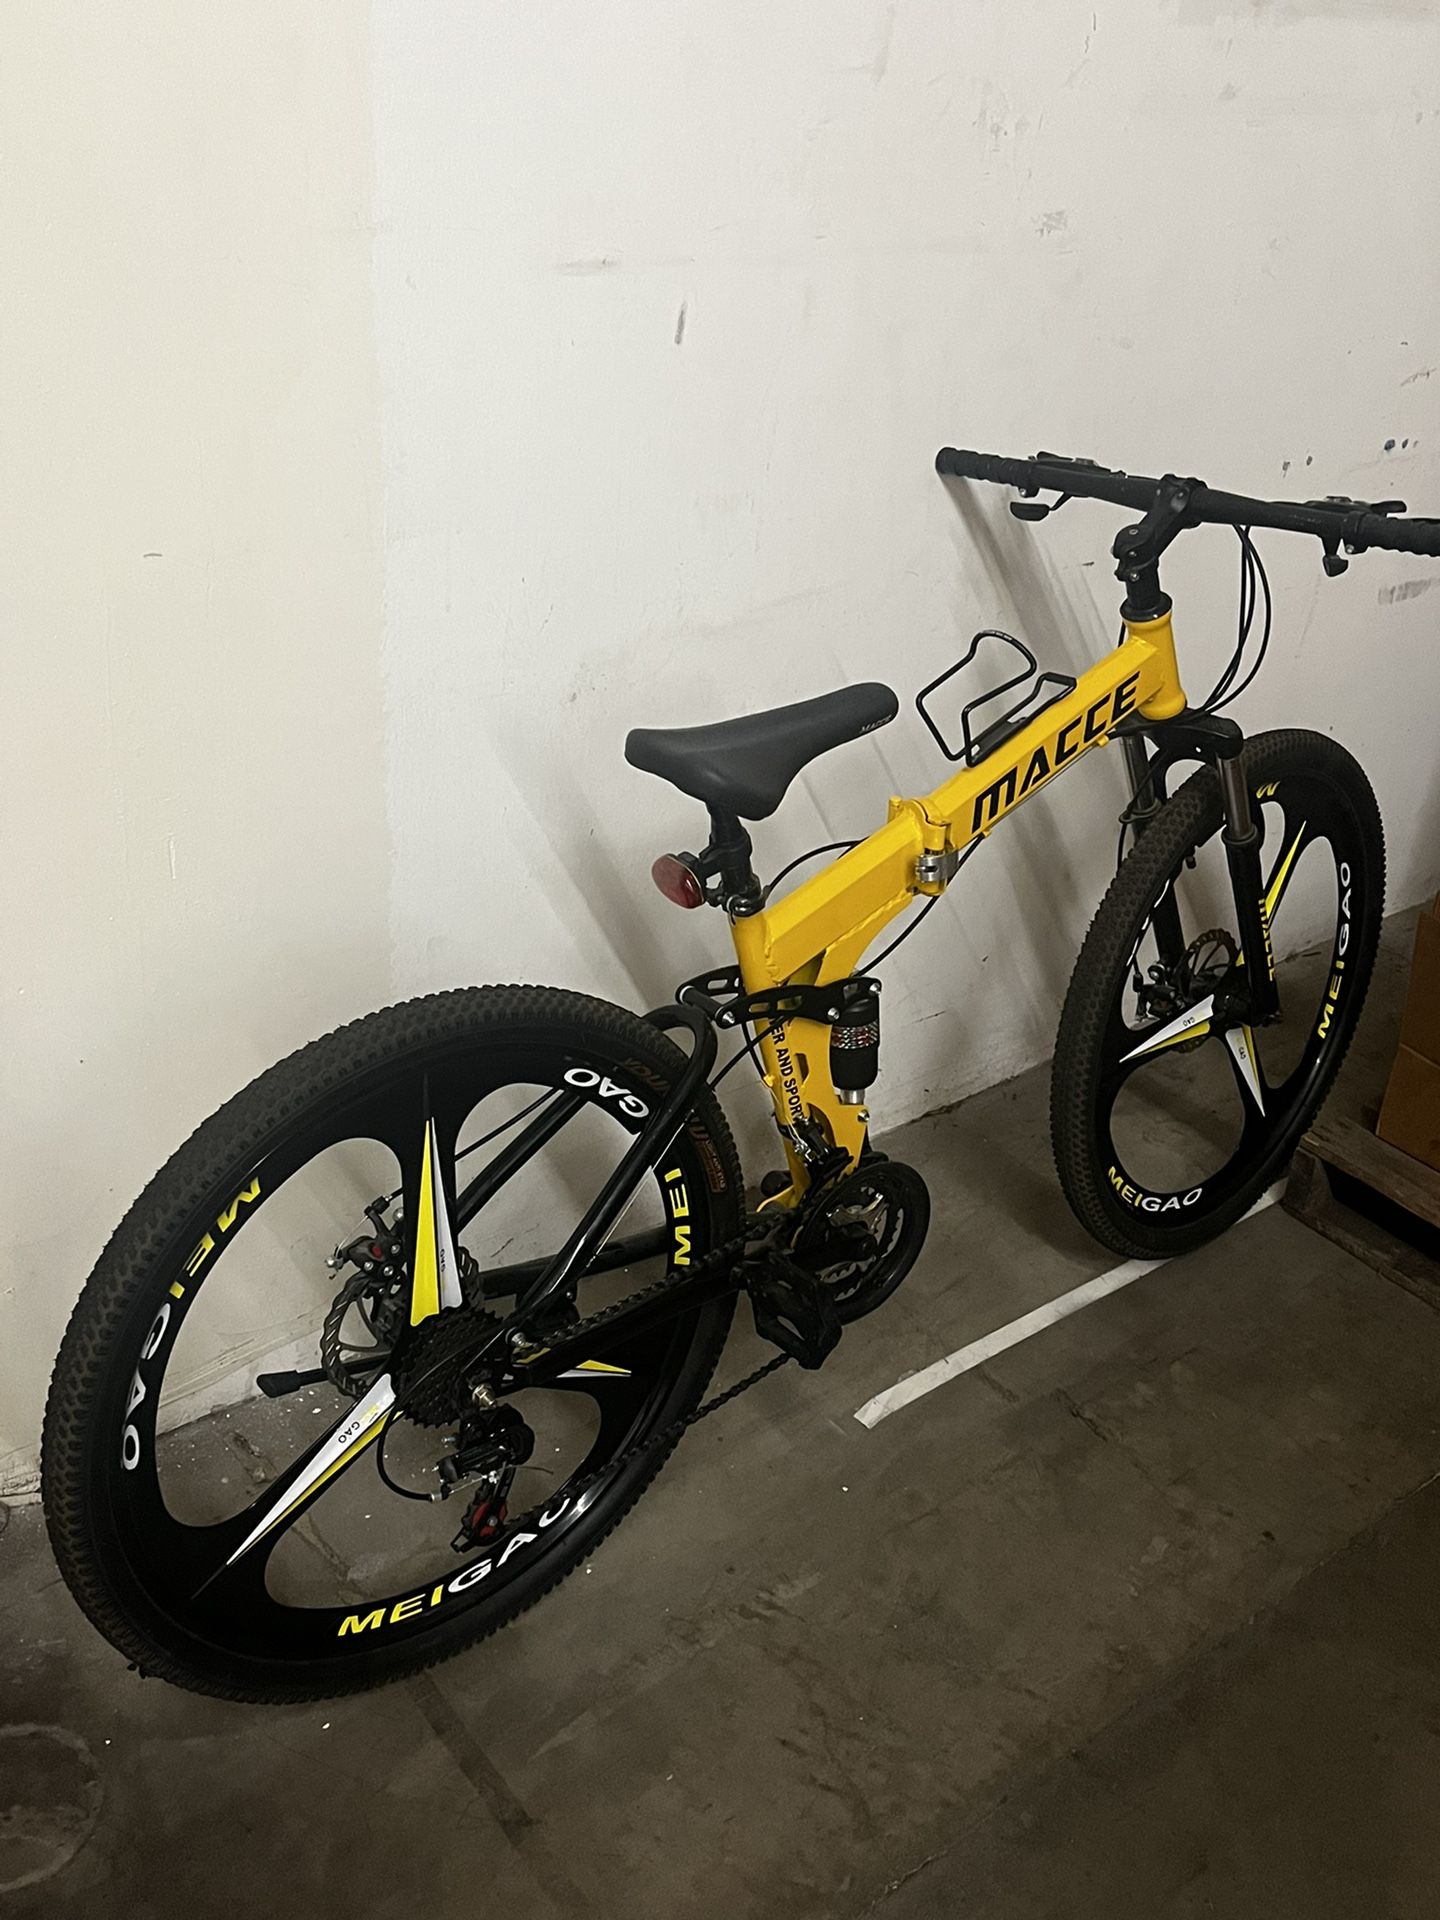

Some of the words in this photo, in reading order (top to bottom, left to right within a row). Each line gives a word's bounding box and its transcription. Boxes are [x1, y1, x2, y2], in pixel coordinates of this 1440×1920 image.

[972, 671, 1140, 833] MACCE
[1317, 862, 1352, 1039] MEIGAO
[776, 1048, 794, 1077] AND
[1108, 1165, 1203, 1212] MEIGAO
[338, 1421, 360, 1443] GAO
